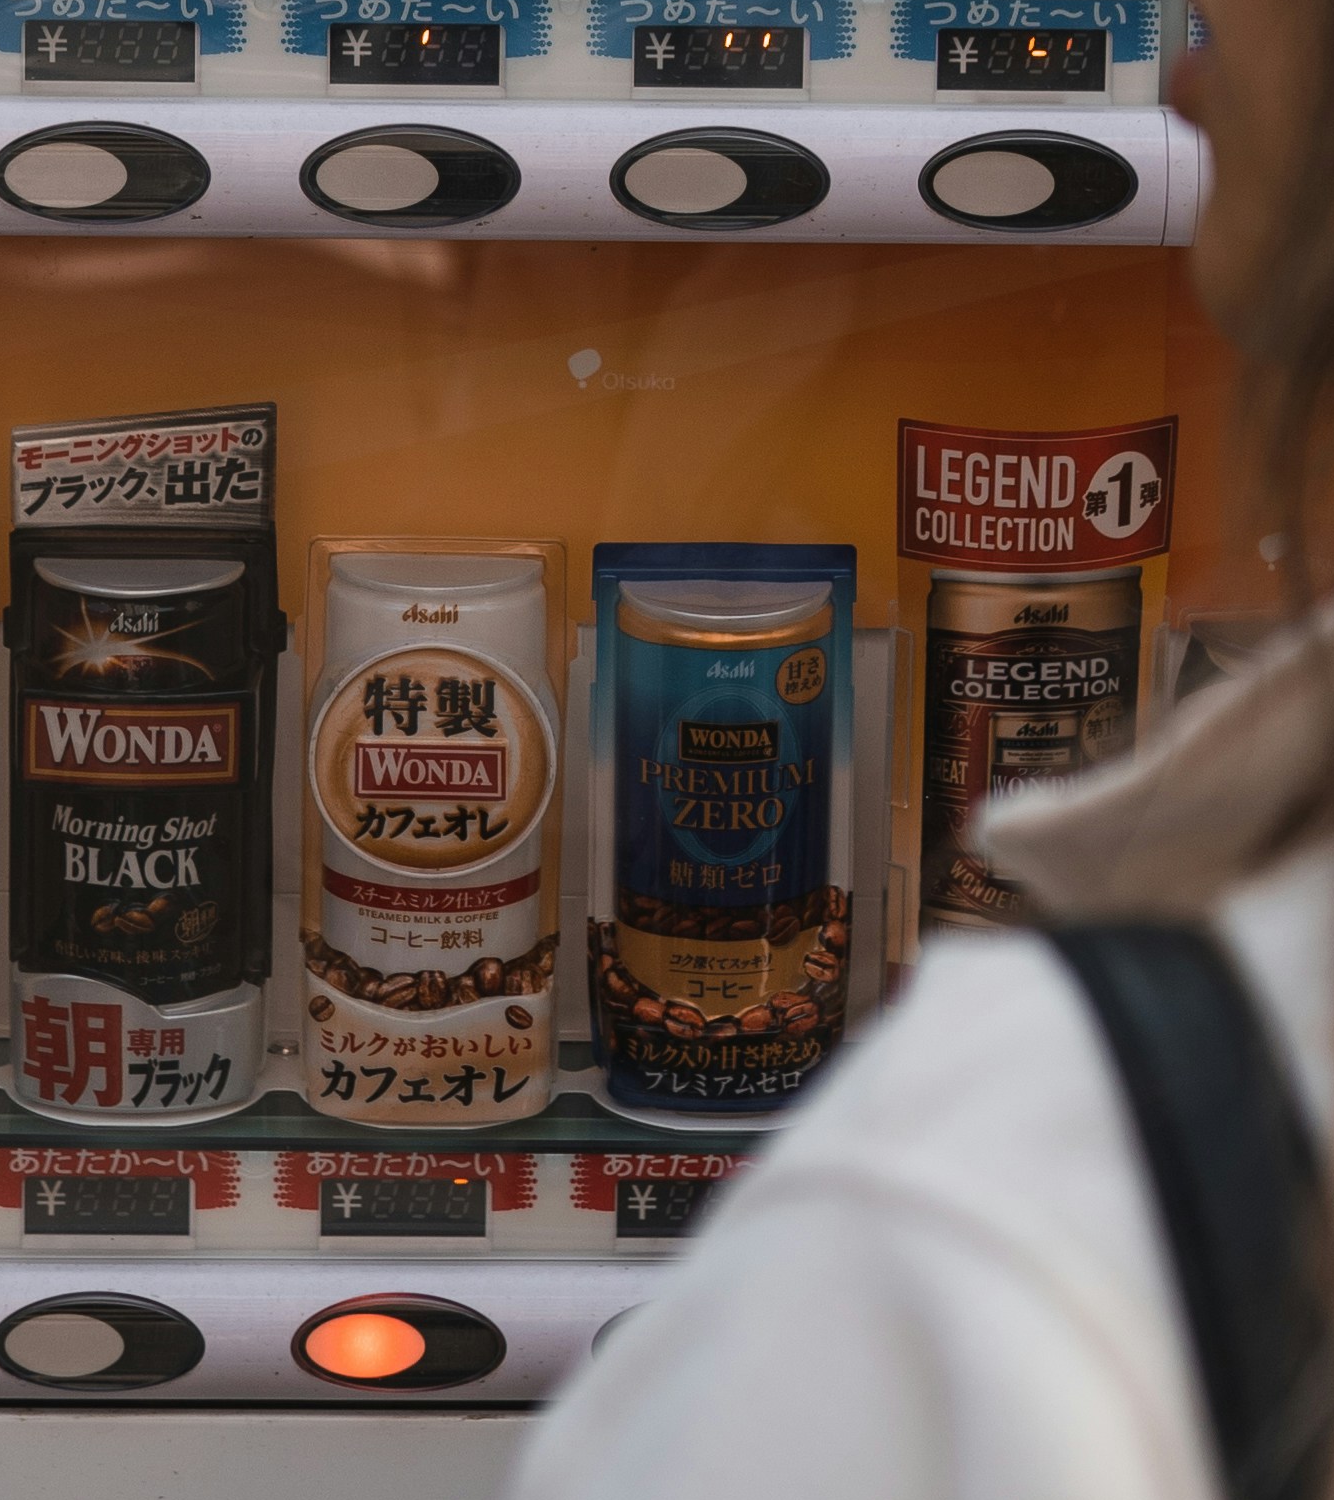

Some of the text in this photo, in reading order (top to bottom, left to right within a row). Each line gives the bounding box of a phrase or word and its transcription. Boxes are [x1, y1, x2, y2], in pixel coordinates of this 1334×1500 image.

[917, 446, 1076, 508] LEGEND
[1084, 461, 1161, 528] 第1弾
[915, 511, 1074, 552] COLLECTION
[1015, 605, 1068, 625] Asahi
[967, 657, 1109, 681] LEGEND
[365, 675, 499, 738] 特製
[952, 677, 1119, 700] COLLECTION
[41, 706, 222, 765] WONDA
[689, 728, 771, 748] WONDA
[367, 750, 493, 788] WONDA
[639, 758, 814, 796] PREMIUM
[52, 805, 217, 849] Morning Shot
[353, 804, 509, 842] カフェオレ
[673, 798, 784, 830] ZERO
[64, 842, 201, 888] BLACK
[369, 925, 484, 951] コーヒー飲料
[23, 995, 122, 1107] 朝
[127, 1027, 185, 1057] 専用
[320, 1027, 532, 1060] ミルクがおいしい
[128, 1053, 231, 1108] ブラック
[320, 1058, 531, 1108] カフェオレ
